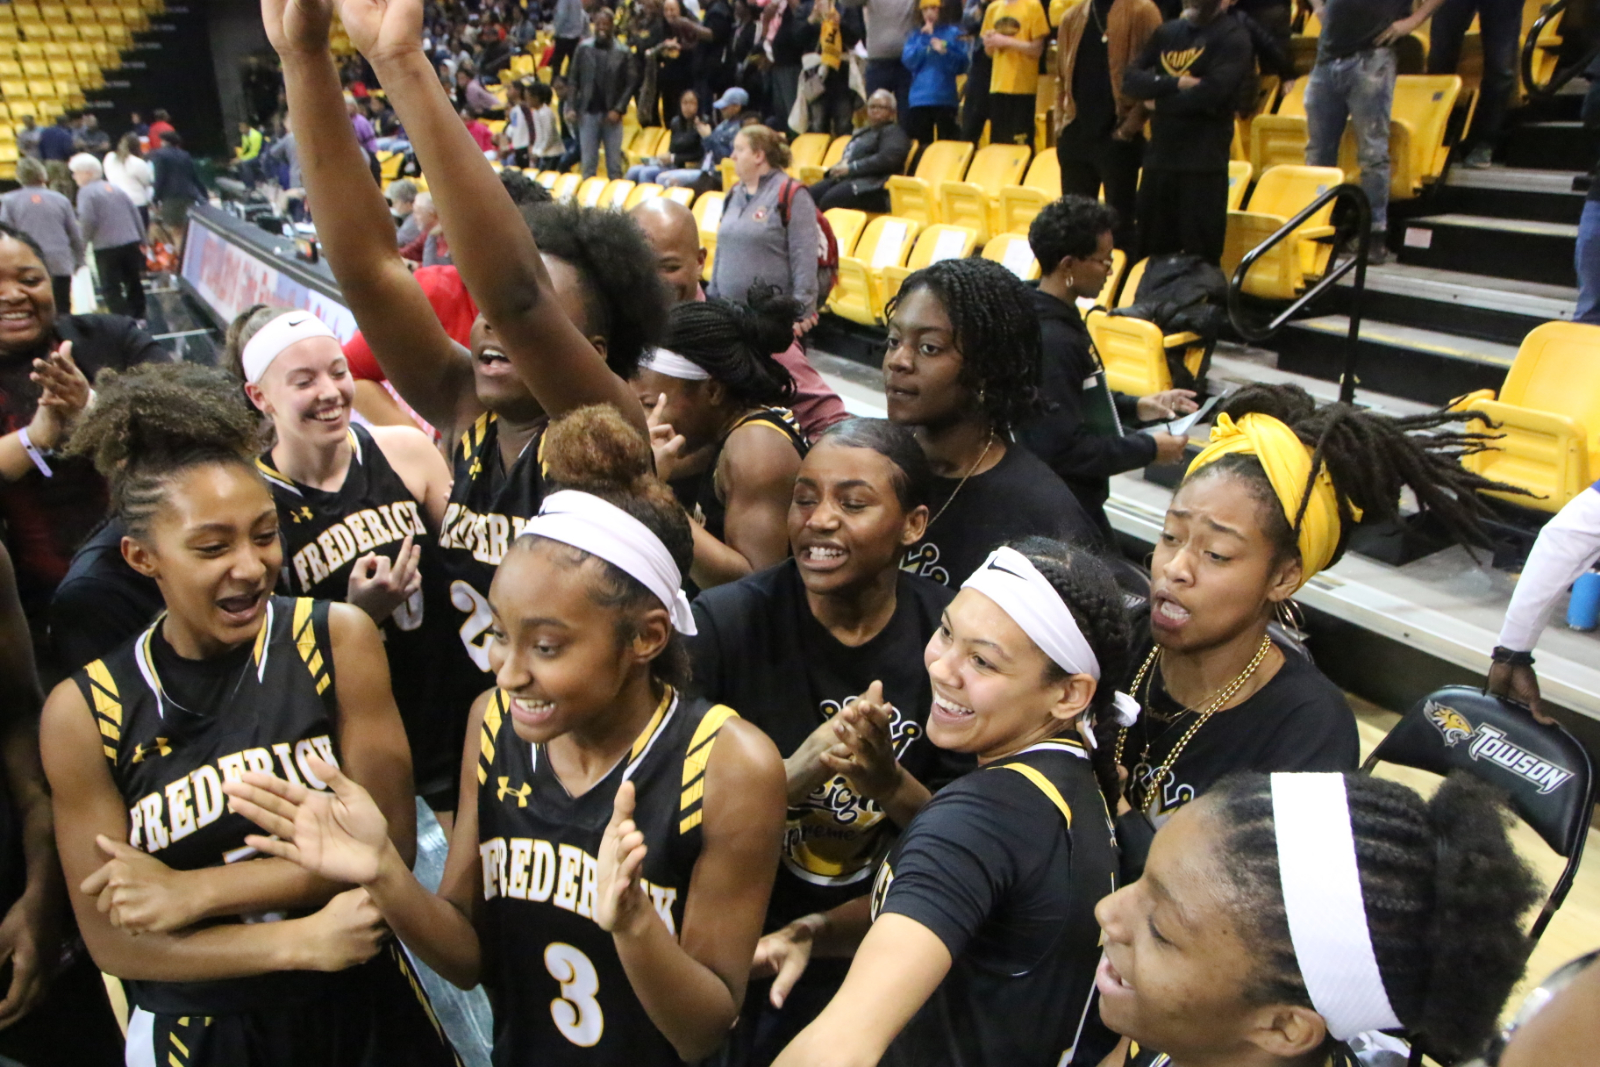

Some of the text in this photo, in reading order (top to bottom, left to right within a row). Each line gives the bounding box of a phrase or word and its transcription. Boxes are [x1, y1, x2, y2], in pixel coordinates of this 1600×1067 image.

[293, 500, 427, 593] FREDERICK
[479, 836, 677, 936] FREDERK
[543, 941, 604, 1047] 3
